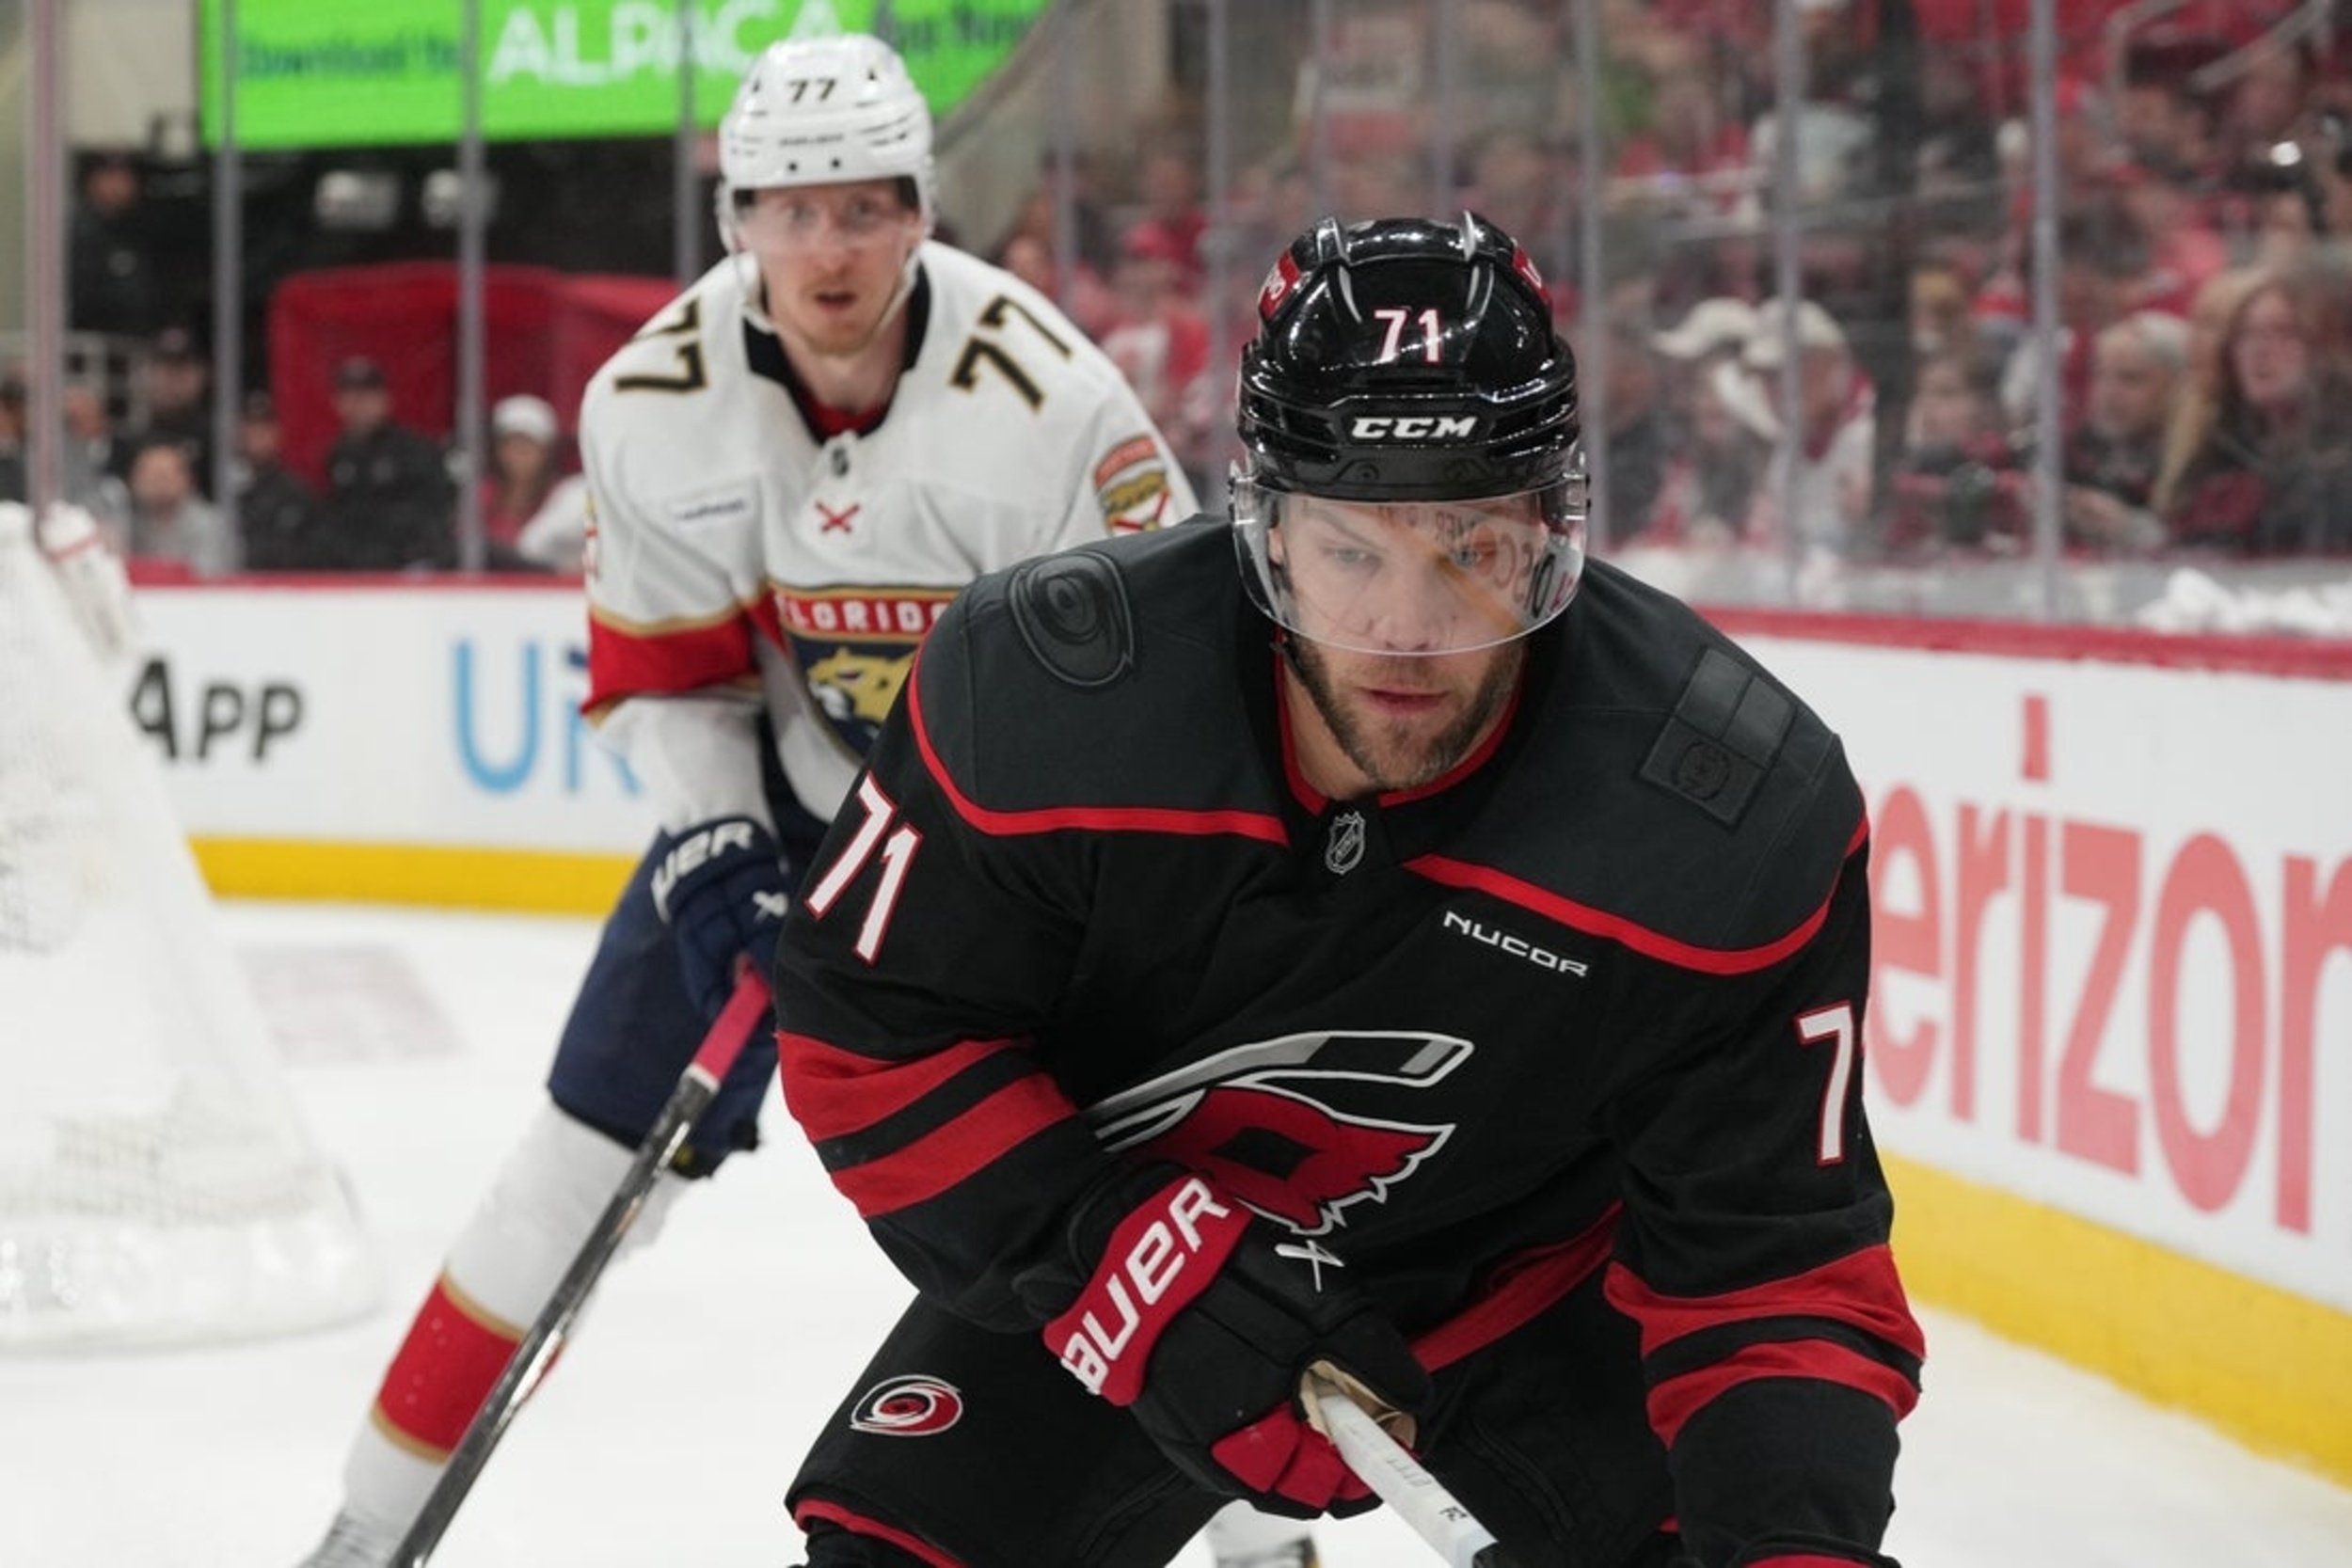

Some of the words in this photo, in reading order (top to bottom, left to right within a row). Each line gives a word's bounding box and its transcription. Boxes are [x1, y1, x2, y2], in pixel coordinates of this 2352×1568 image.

[787, 77, 835, 103] 77
[947, 293, 1072, 415] 77
[1372, 308, 1442, 365] 71
[1351, 416, 1478, 438] CCM
[803, 770, 924, 969] 71
[1442, 910, 1590, 978] NUCOR
[1793, 999, 1865, 1167] 7
